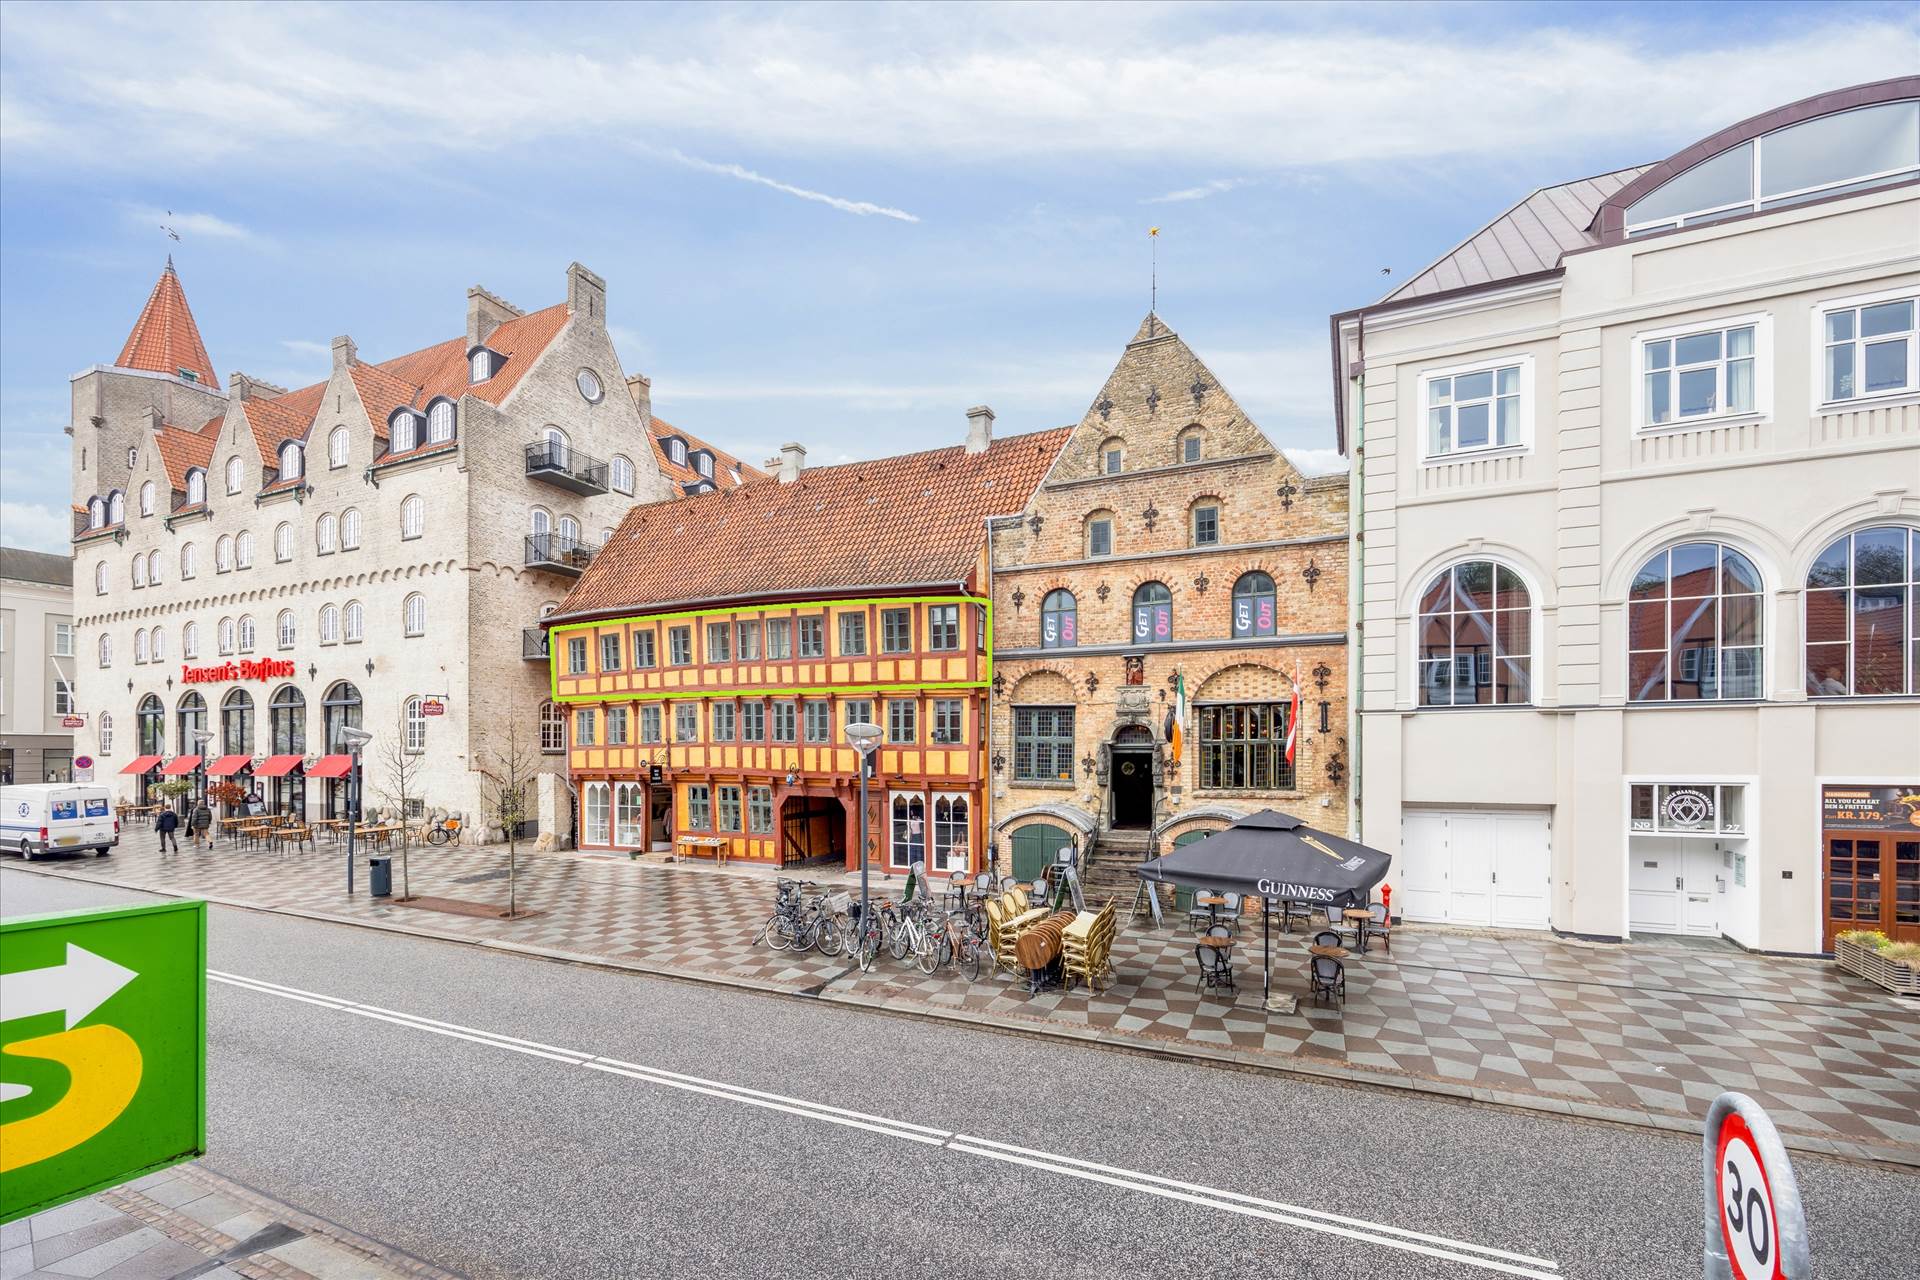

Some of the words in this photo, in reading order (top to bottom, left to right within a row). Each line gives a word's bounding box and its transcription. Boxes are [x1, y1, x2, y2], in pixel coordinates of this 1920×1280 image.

[1062, 615, 1073, 640] OUT
[1136, 608, 1149, 637] GET
[1156, 610, 1168, 637] OUT
[1236, 602, 1251, 630] GET
[1258, 600, 1271, 629] OUT
[1045, 616, 1056, 642] GET
[181, 661, 239, 684] Jensen's
[1726, 824, 1740, 832] 27
[1837, 811, 1857, 819] KR.
[1257, 878, 1334, 902] GUINNESS
[1727, 1160, 1769, 1266] 30
